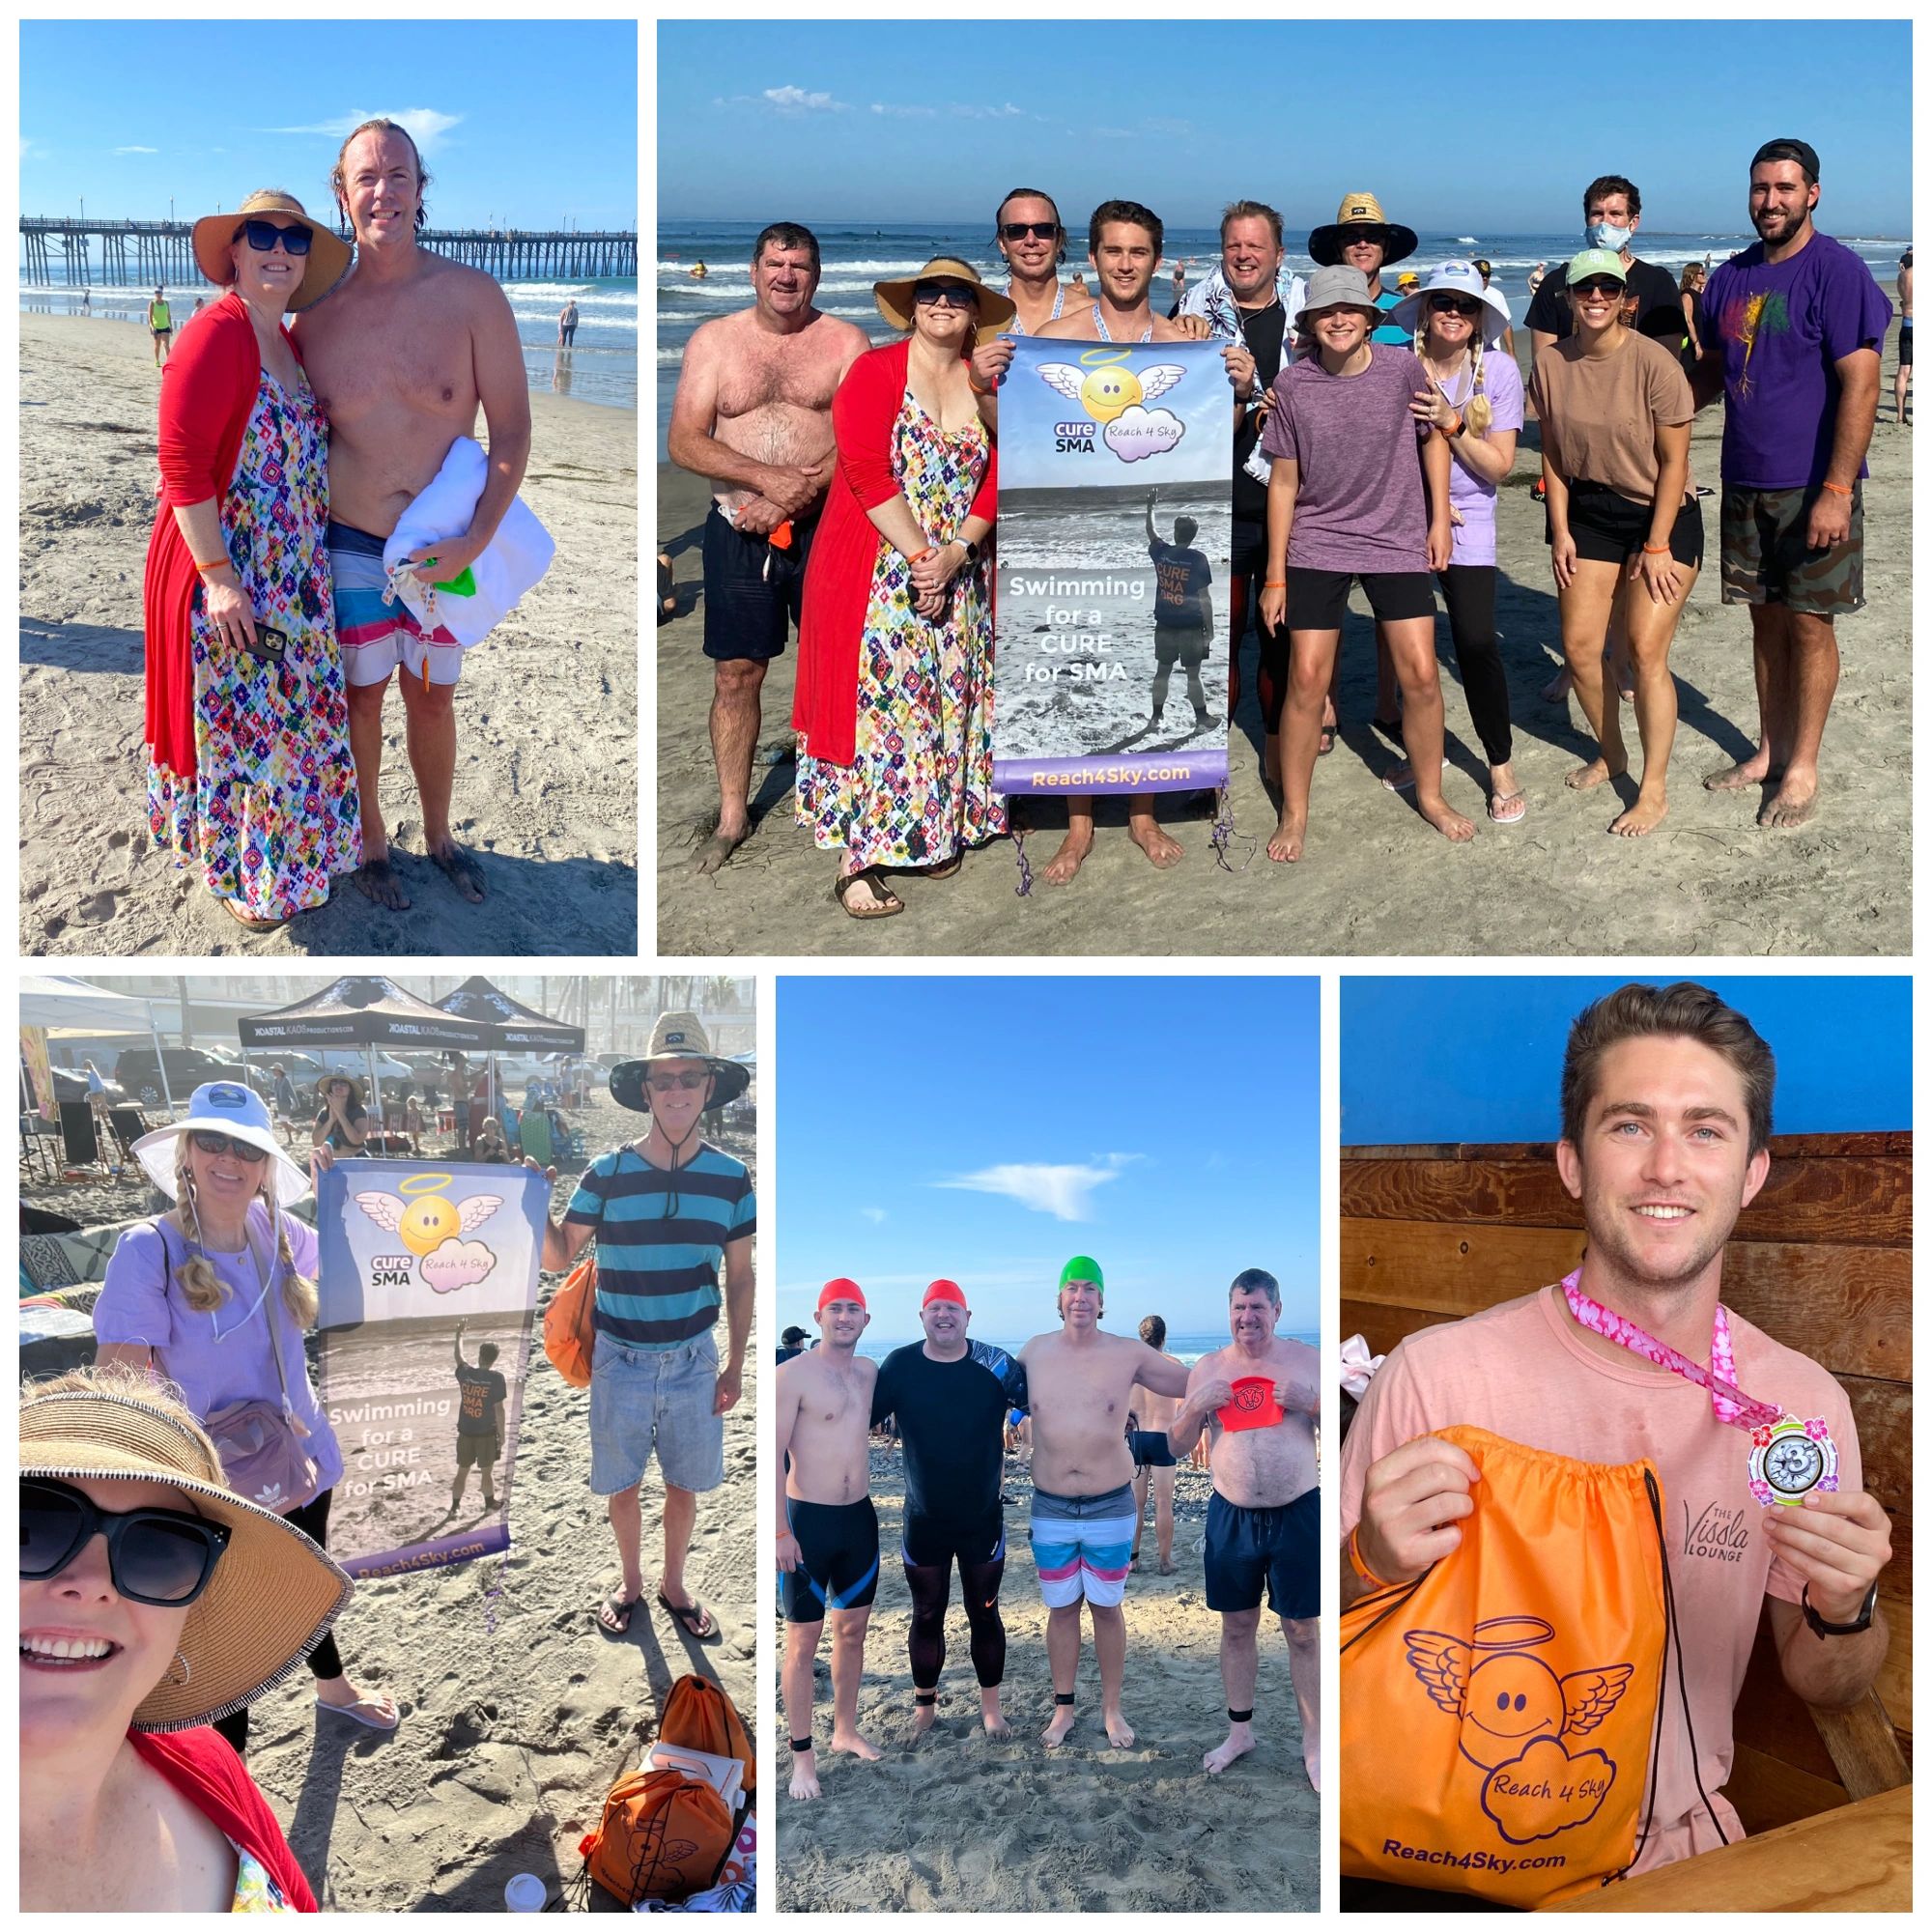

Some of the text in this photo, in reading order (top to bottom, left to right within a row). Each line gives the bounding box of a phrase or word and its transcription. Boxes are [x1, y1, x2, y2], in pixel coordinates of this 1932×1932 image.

[1055, 423, 1094, 436] cure
[1108, 426, 1177, 440] Reach 4 Sky
[1055, 439, 1094, 452] SMA
[1156, 562, 1190, 582] CURE
[1009, 576, 1145, 600] Swimming
[1159, 575, 1183, 593] SMA
[1045, 605, 1102, 625] for a
[1040, 634, 1112, 653] CURE
[1025, 662, 1127, 682] for SMA
[1032, 767, 1190, 787] Reach4Sky.com
[372, 1256, 412, 1269] cure
[425, 1258, 456, 1269] Reach
[470, 1258, 489, 1271] Sky
[372, 1271, 411, 1287] SMA
[462, 1382, 491, 1398] CURE
[329, 1398, 451, 1426] Swimming
[361, 1428, 413, 1447] for a
[357, 1448, 422, 1471] CURE
[344, 1469, 433, 1498] for SMA
[1714, 1508, 1732, 1520] THE
[1683, 1499, 1748, 1555] Vissla
[358, 1542, 485, 1578] Reach4Sky.com
[1689, 1543, 1743, 1562] LOUNGE
[1493, 1774, 1605, 1803] Reach 4 Sky
[1382, 1839, 1566, 1874] Reach4Sky.com
